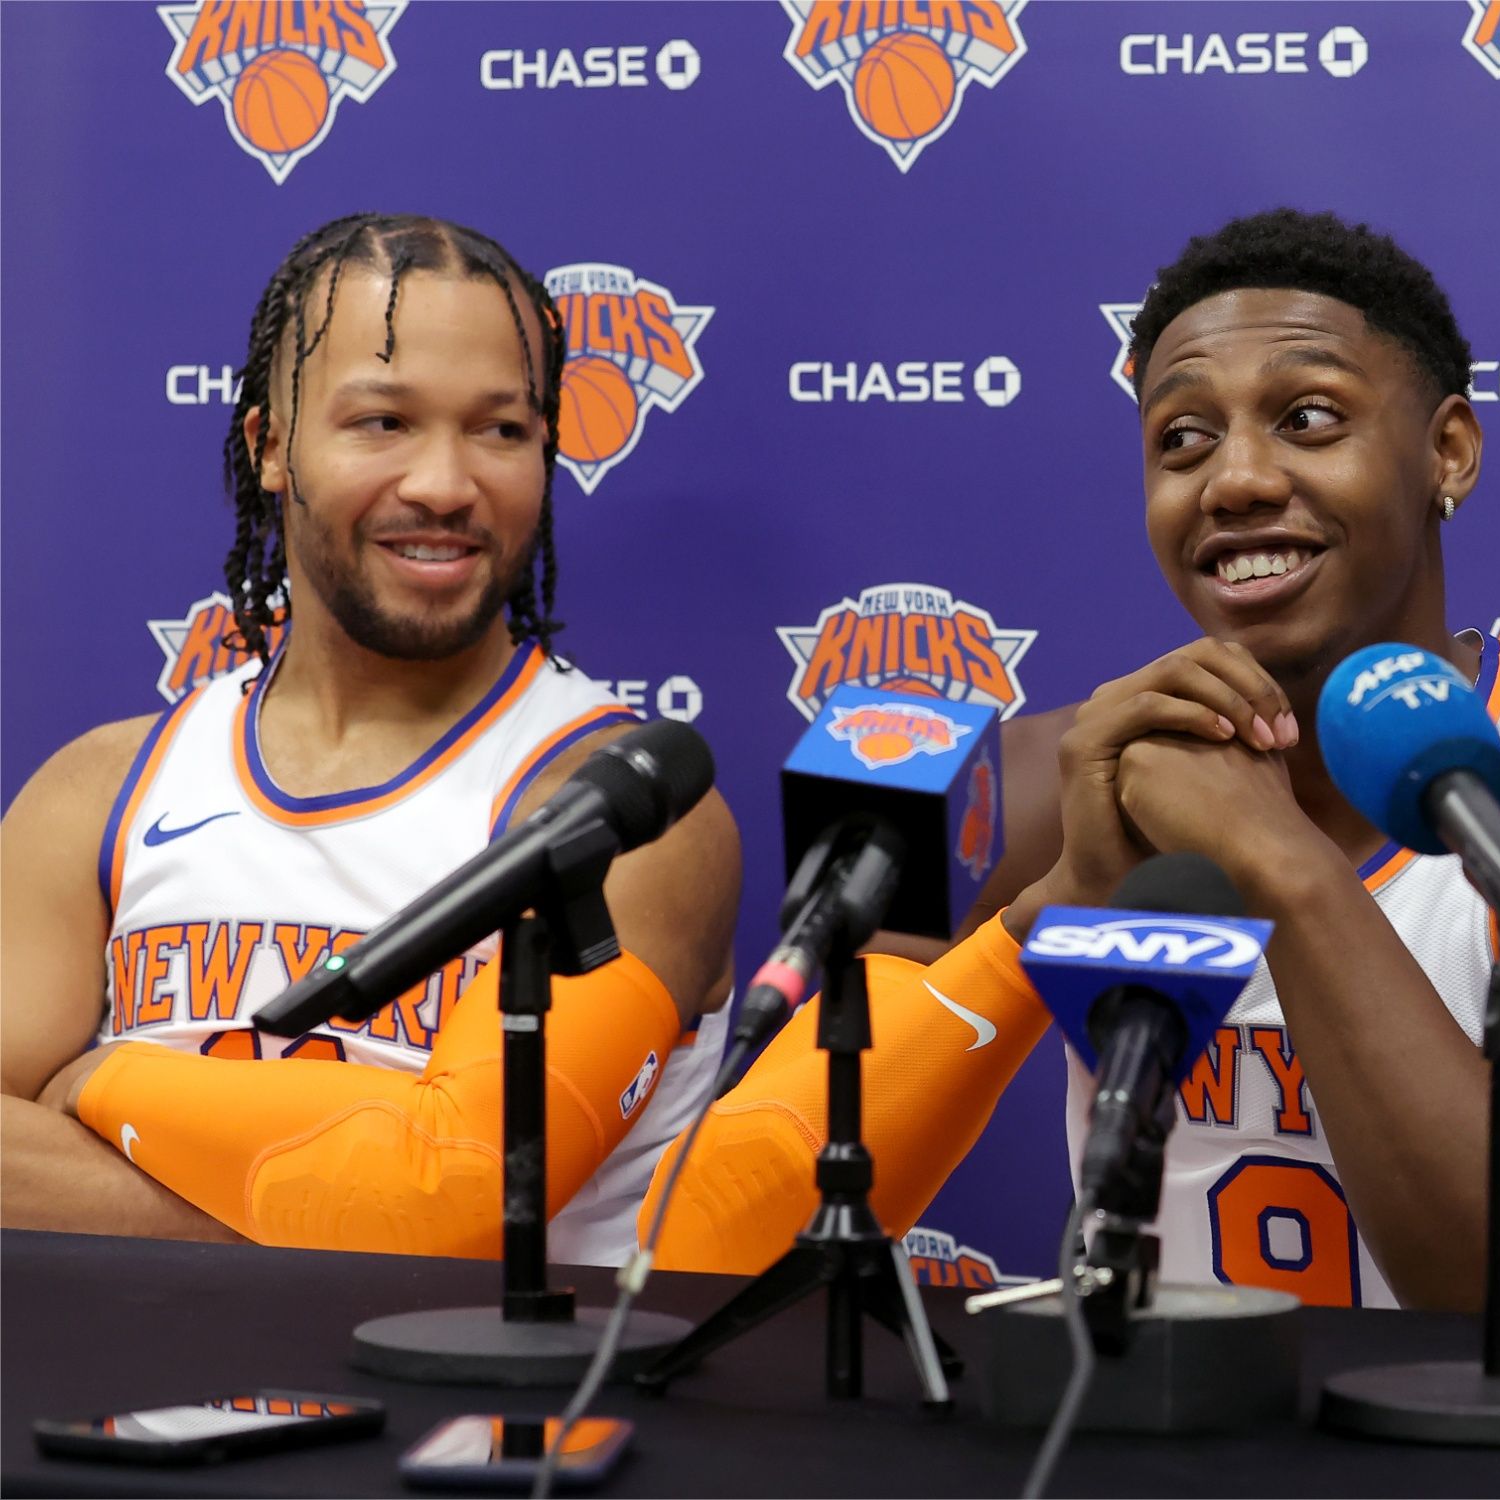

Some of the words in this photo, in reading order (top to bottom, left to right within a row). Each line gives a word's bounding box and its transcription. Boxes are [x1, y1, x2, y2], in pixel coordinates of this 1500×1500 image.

[176, 0, 386, 75] KNICKS
[1120, 33, 1309, 74] CHASE
[481, 47, 648, 89] CHASE
[555, 288, 695, 380] ICKS
[789, 362, 964, 402] CHASE
[862, 591, 899, 614] NEW
[904, 591, 949, 614] YORK
[797, 609, 1016, 705] KNICKS
[1347, 651, 1425, 706] AFP
[1391, 679, 1449, 710] TV
[1027, 924, 1228, 965] SNY
[112, 920, 263, 1038] NEW
